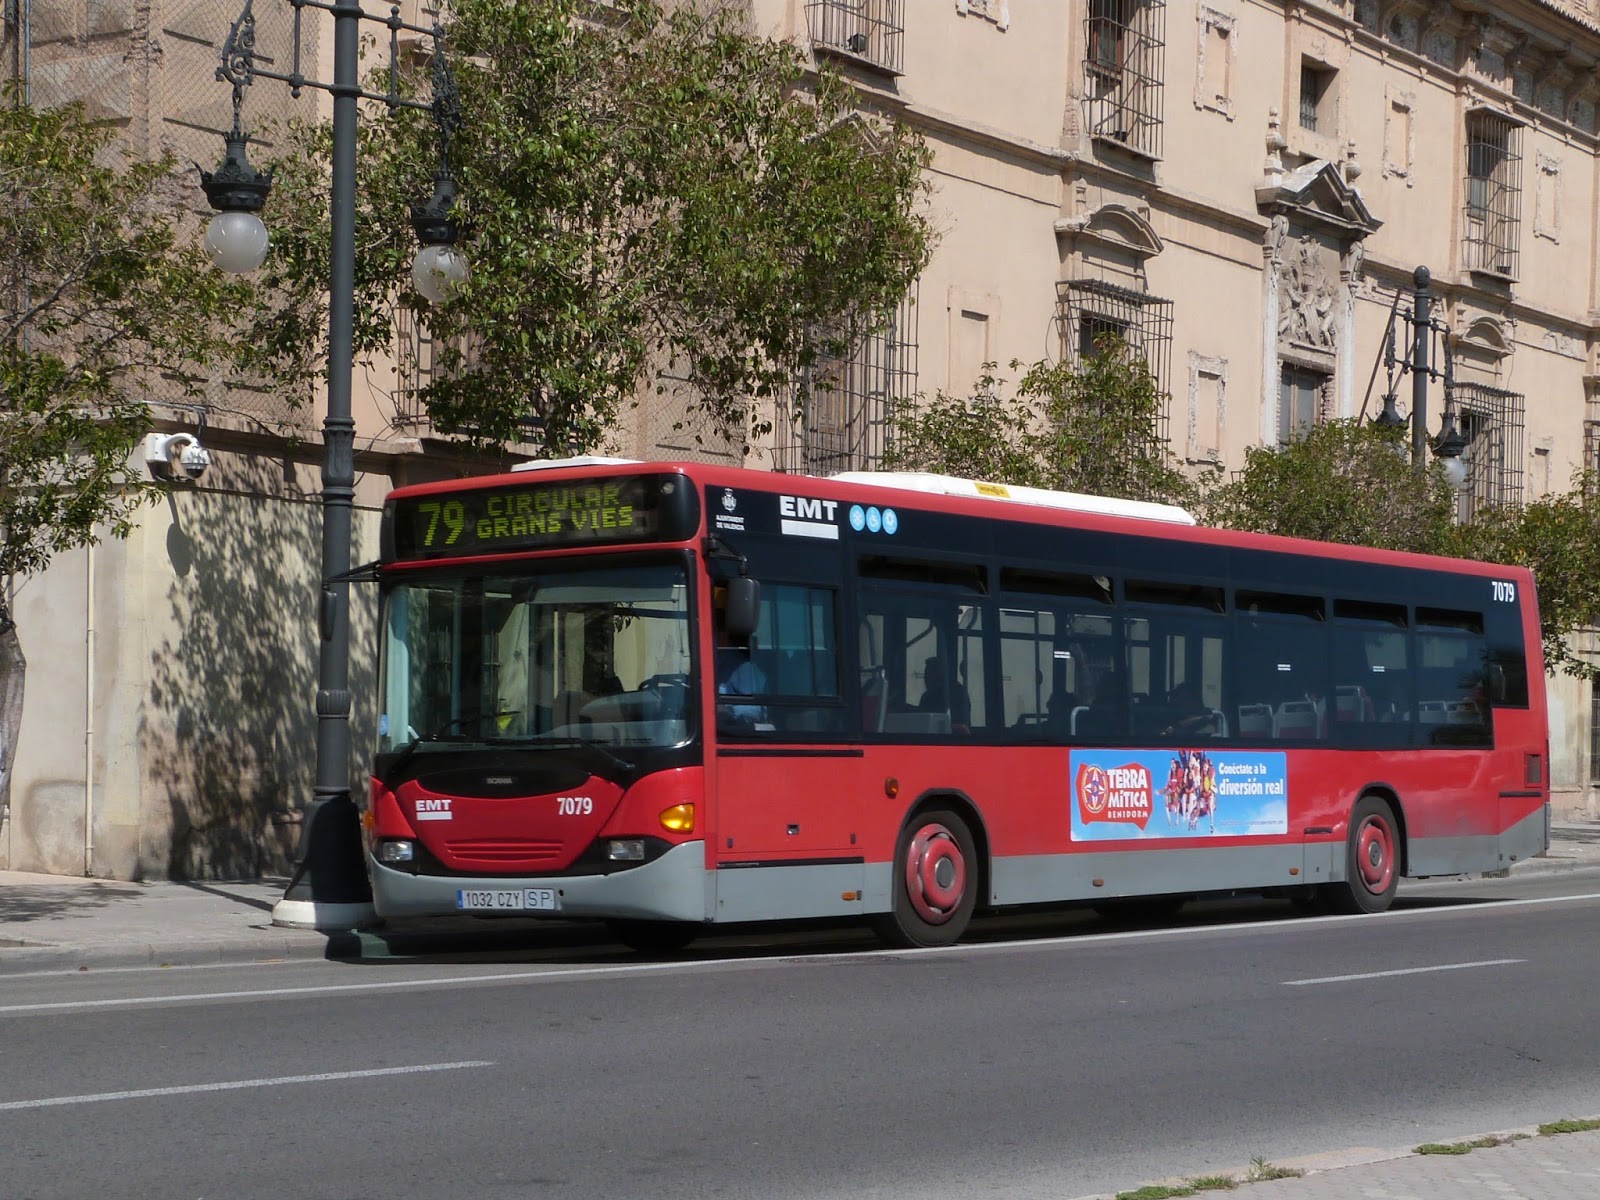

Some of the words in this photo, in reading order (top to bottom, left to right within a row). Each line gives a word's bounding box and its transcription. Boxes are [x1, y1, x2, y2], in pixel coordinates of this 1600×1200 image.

[487, 486, 619, 516] CIRCULAR
[779, 495, 839, 521] EMT
[418, 501, 465, 546] 79
[476, 512, 561, 538] GRANS
[572, 506, 633, 530] VIES
[1492, 581, 1514, 602] 7079
[1253, 765, 1259, 775] a
[1259, 763, 1267, 775] la
[1107, 769, 1148, 789] TERRA
[1219, 777, 1262, 795] diversión
[1264, 778, 1284, 795] real
[415, 800, 452, 811] EMT
[556, 797, 593, 815] 7079
[1107, 810, 1149, 819] BENIDORM
[466, 892, 493, 907] 1032
[497, 892, 520, 907] CZY
[527, 891, 551, 907] SP
